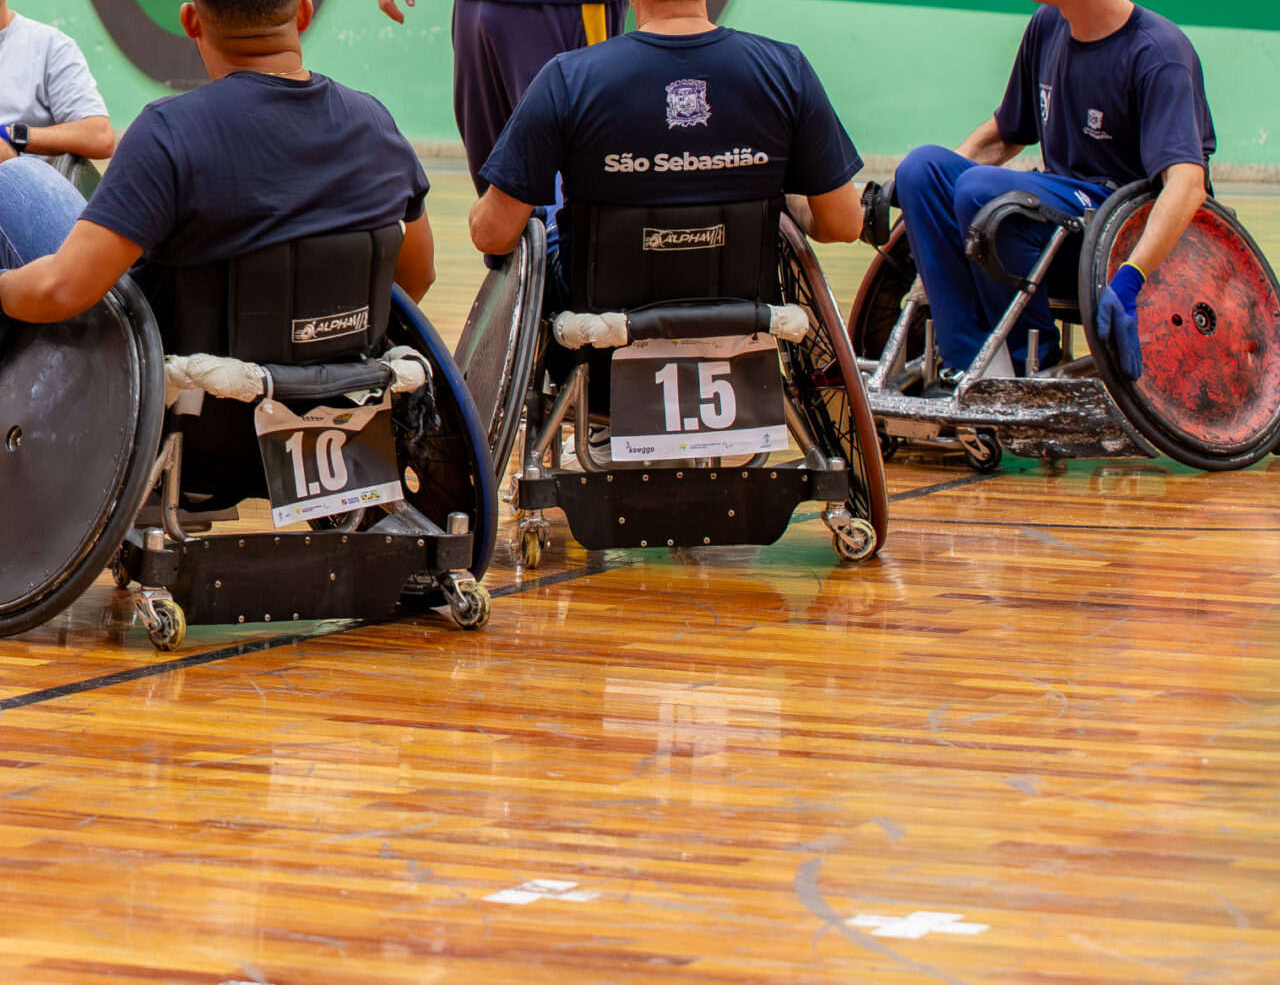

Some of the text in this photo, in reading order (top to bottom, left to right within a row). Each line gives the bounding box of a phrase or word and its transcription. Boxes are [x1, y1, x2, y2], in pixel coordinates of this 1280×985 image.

[604, 148, 769, 173] São Sebastião
[655, 361, 736, 432] 1.5
[285, 429, 348, 499] 1.0
